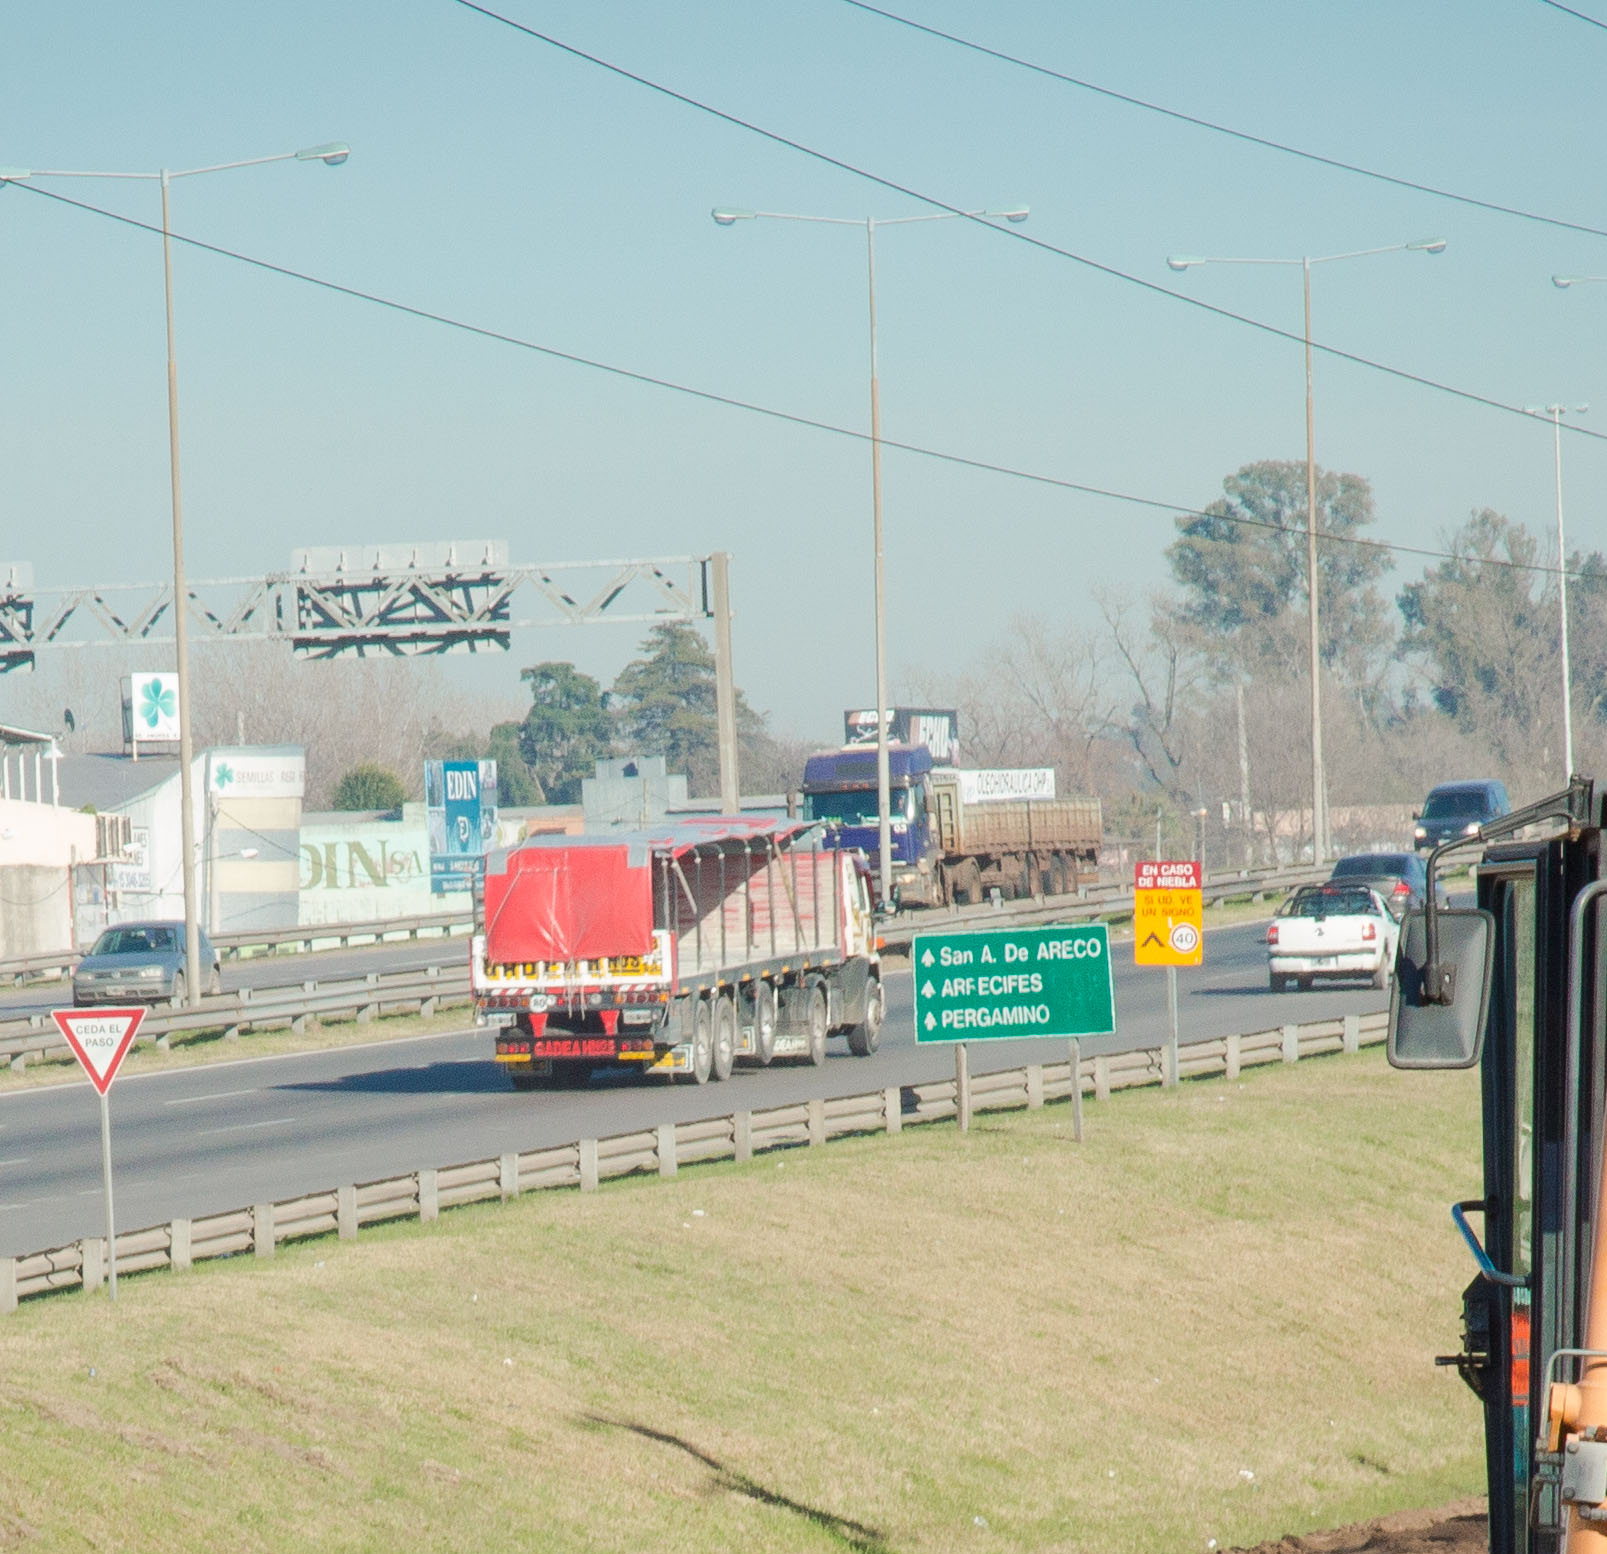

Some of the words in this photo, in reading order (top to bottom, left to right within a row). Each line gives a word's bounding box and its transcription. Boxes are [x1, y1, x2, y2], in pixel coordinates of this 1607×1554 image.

[446, 770, 477, 800] EDIN
[299, 840, 391, 890] DIN
[1142, 865, 1158, 876] EN
[1160, 864, 1193, 876] CASO
[1138, 877, 1154, 888] DE
[1157, 877, 1196, 888] NIEBLA
[1176, 932, 1194, 944] 40
[940, 946, 973, 966] San
[981, 944, 997, 963] A.
[1005, 943, 1029, 962] De
[1037, 938, 1102, 960] ARECO
[942, 1004, 1050, 1029] PERGAMINO
[75, 1024, 106, 1035] CEDA
[109, 1024, 122, 1034] EL
[85, 1037, 114, 1048] PASO
